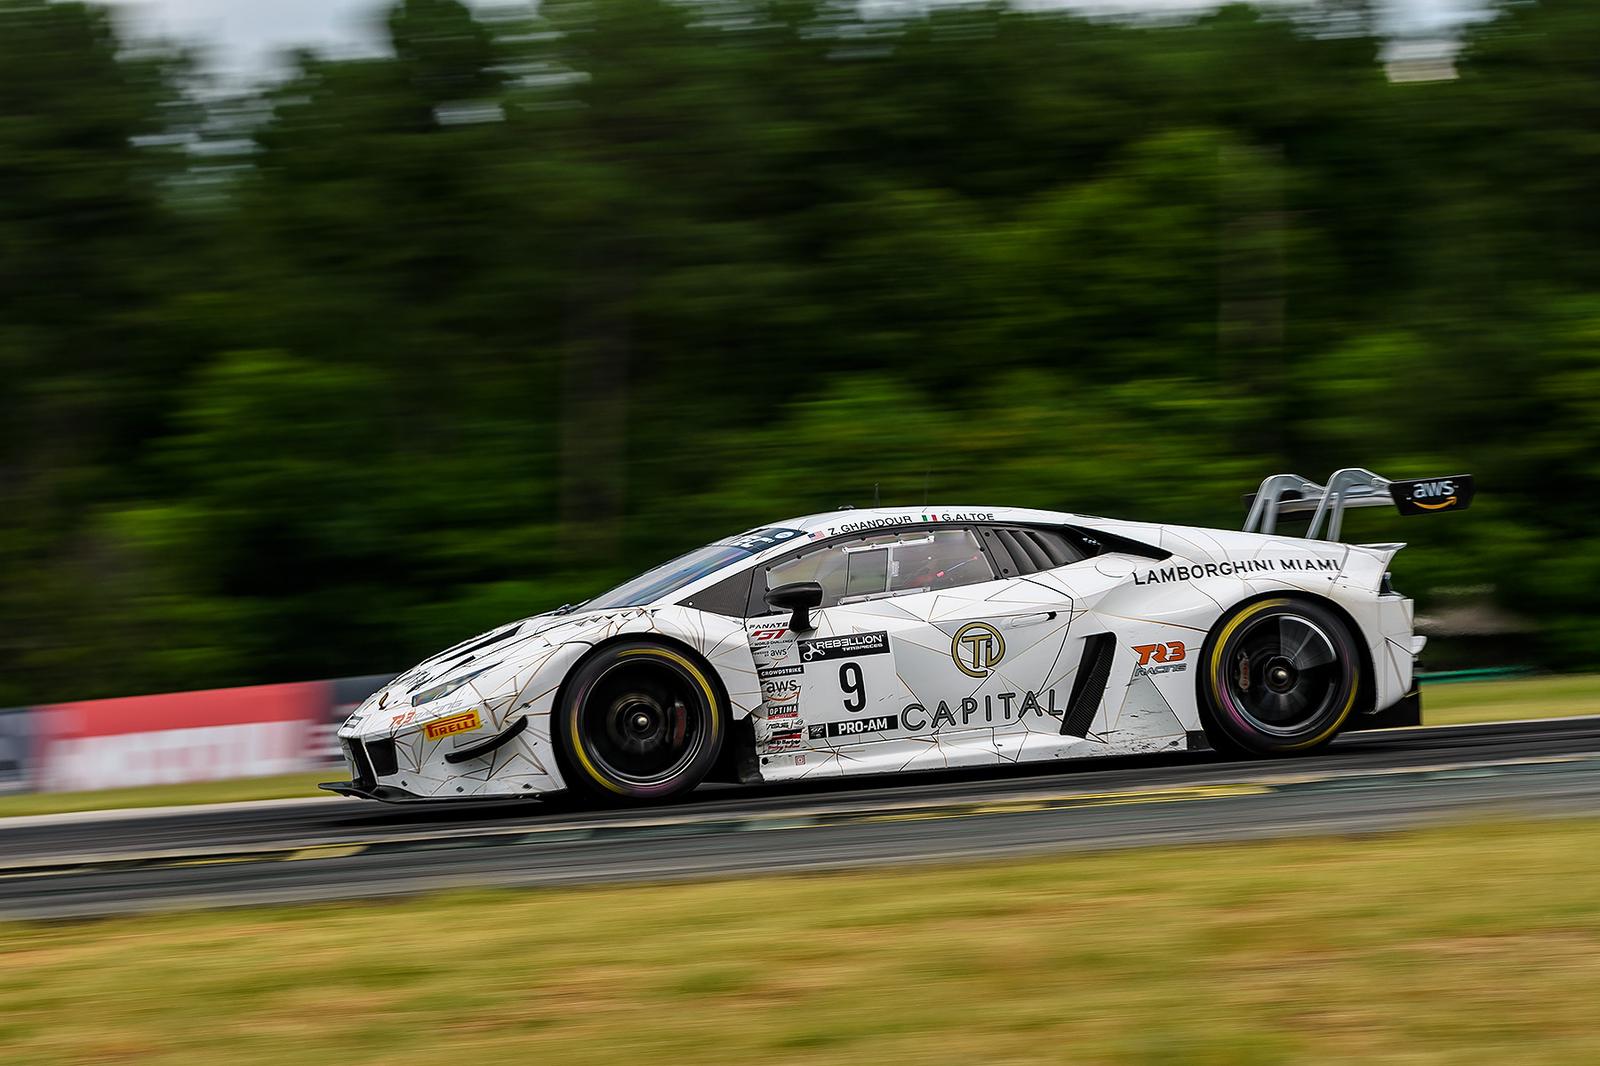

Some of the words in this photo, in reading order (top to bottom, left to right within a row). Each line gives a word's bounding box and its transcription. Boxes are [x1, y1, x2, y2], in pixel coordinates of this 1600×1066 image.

[1413, 480, 1455, 498] aws
[1132, 559, 1275, 586] LAMBORGHINI
[1280, 559, 1341, 572] MIAMI
[749, 621, 789, 629] FANATE
[815, 634, 883, 650] REBELLION
[770, 648, 788, 657] aws
[1130, 640, 1186, 666] TR3
[761, 667, 802, 677] CROWDSTRIKE
[766, 680, 798, 693] aws
[838, 661, 867, 713] 9
[769, 704, 798, 715] OPTIMA
[901, 689, 1064, 731] CAPITAL
[426, 713, 476, 738] PIRELLI
[837, 717, 888, 735] PRO-AM
